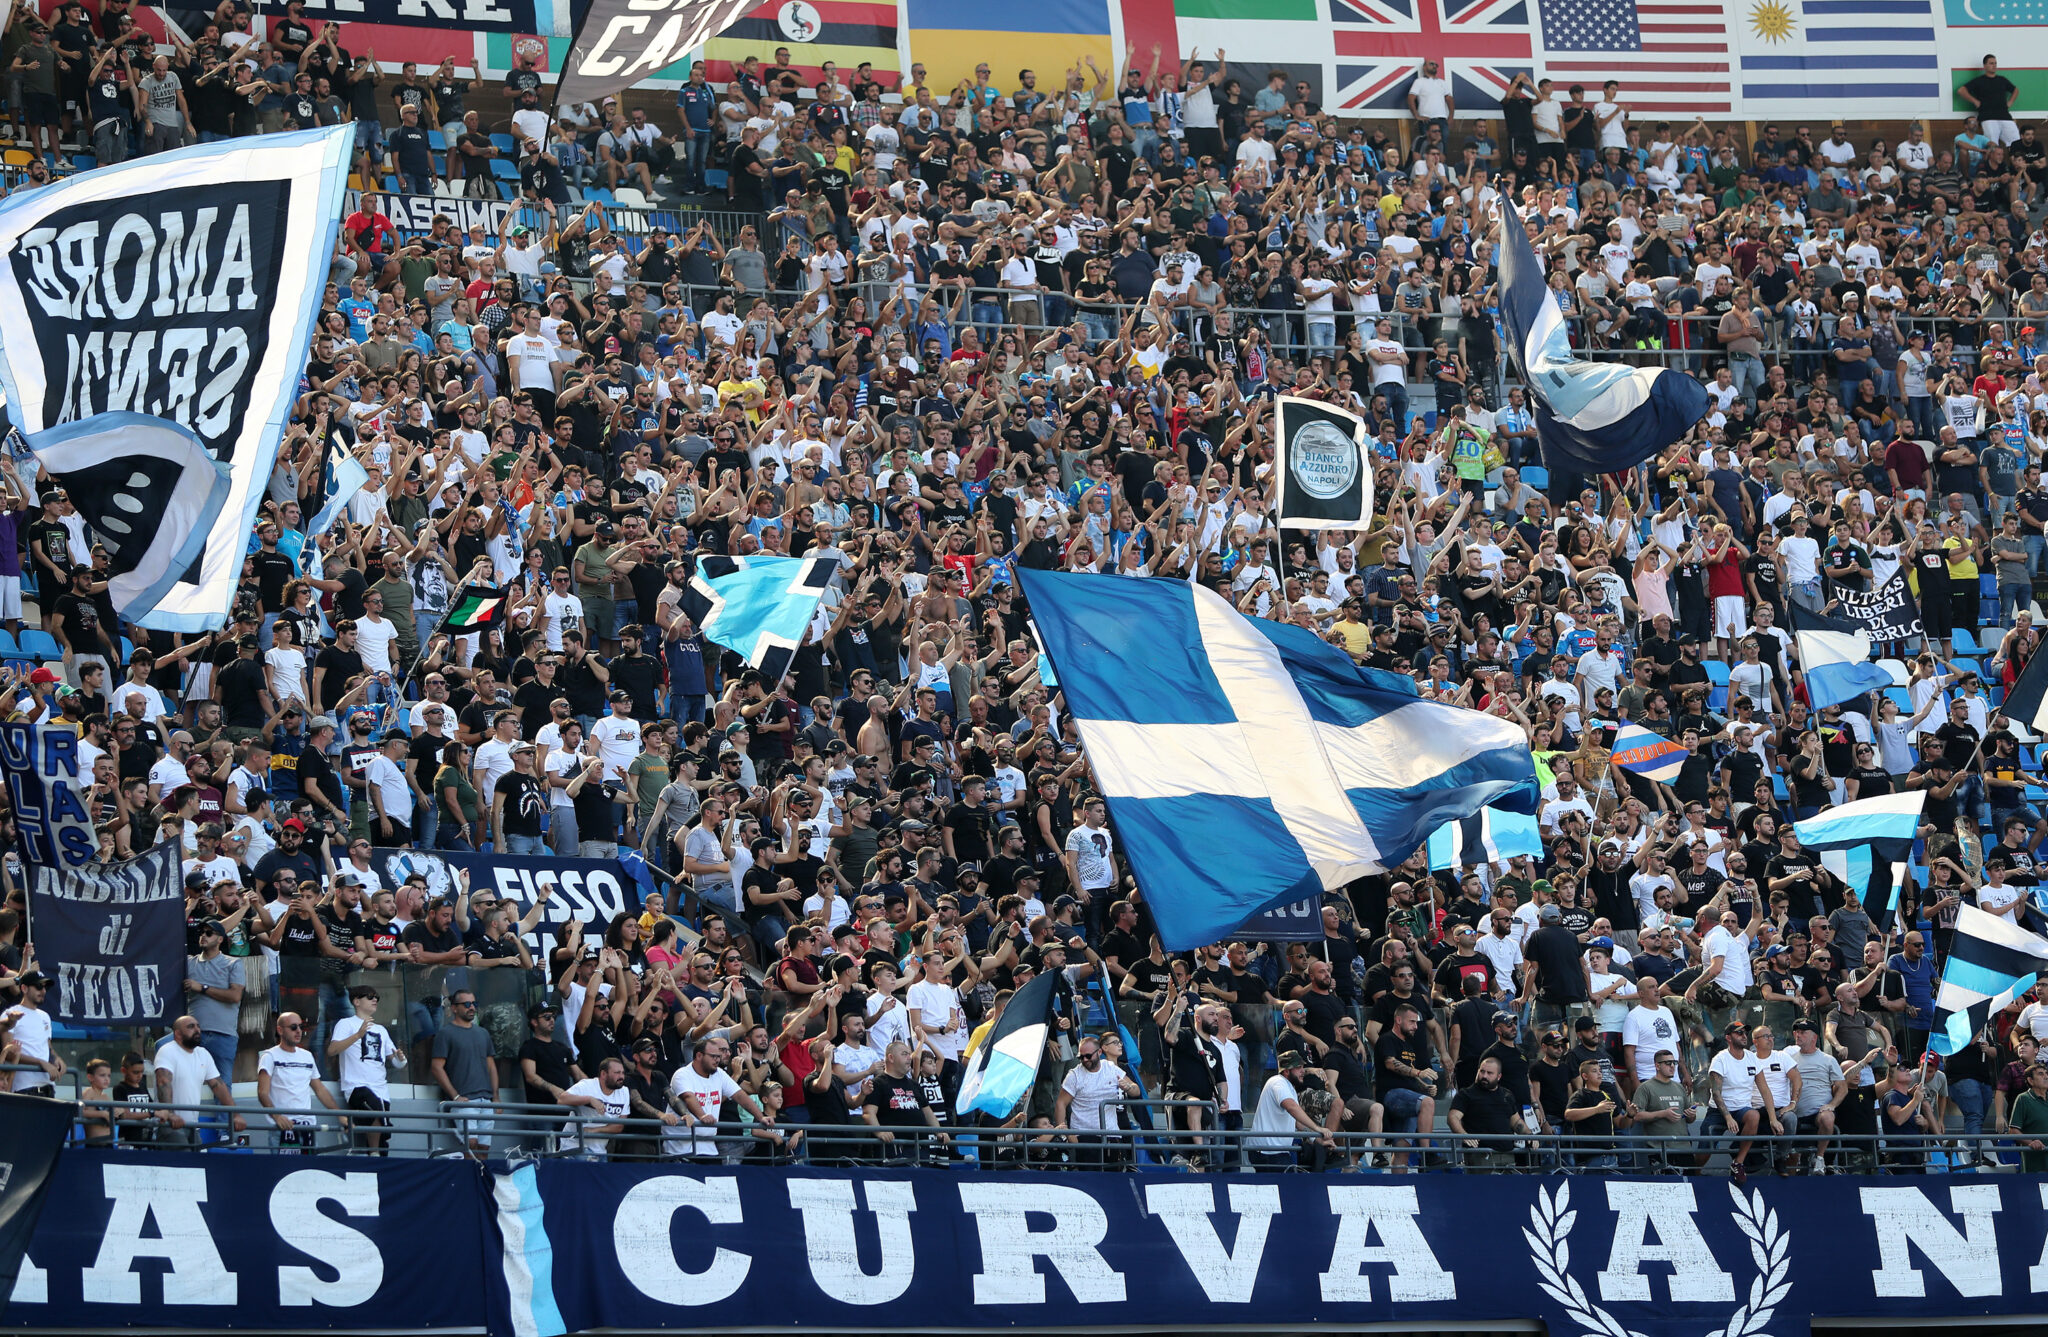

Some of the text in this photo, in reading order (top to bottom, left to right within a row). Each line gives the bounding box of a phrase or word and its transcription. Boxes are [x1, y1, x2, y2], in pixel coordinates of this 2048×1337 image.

[1300, 461, 1349, 475] AZZURRO
[1305, 452, 1343, 463] BIANCO
[1307, 475, 1340, 485] NAPOLI
[1835, 576, 1905, 605] ULTRAS
[1843, 592, 1906, 620] LIBERI
[1867, 615, 1889, 630] DI
[1620, 742, 1669, 763] NAPOLI
[98, 914, 133, 956] di
[58, 961, 164, 1021] FEDE
[10, 1163, 2048, 1308] AS CURVA A N
